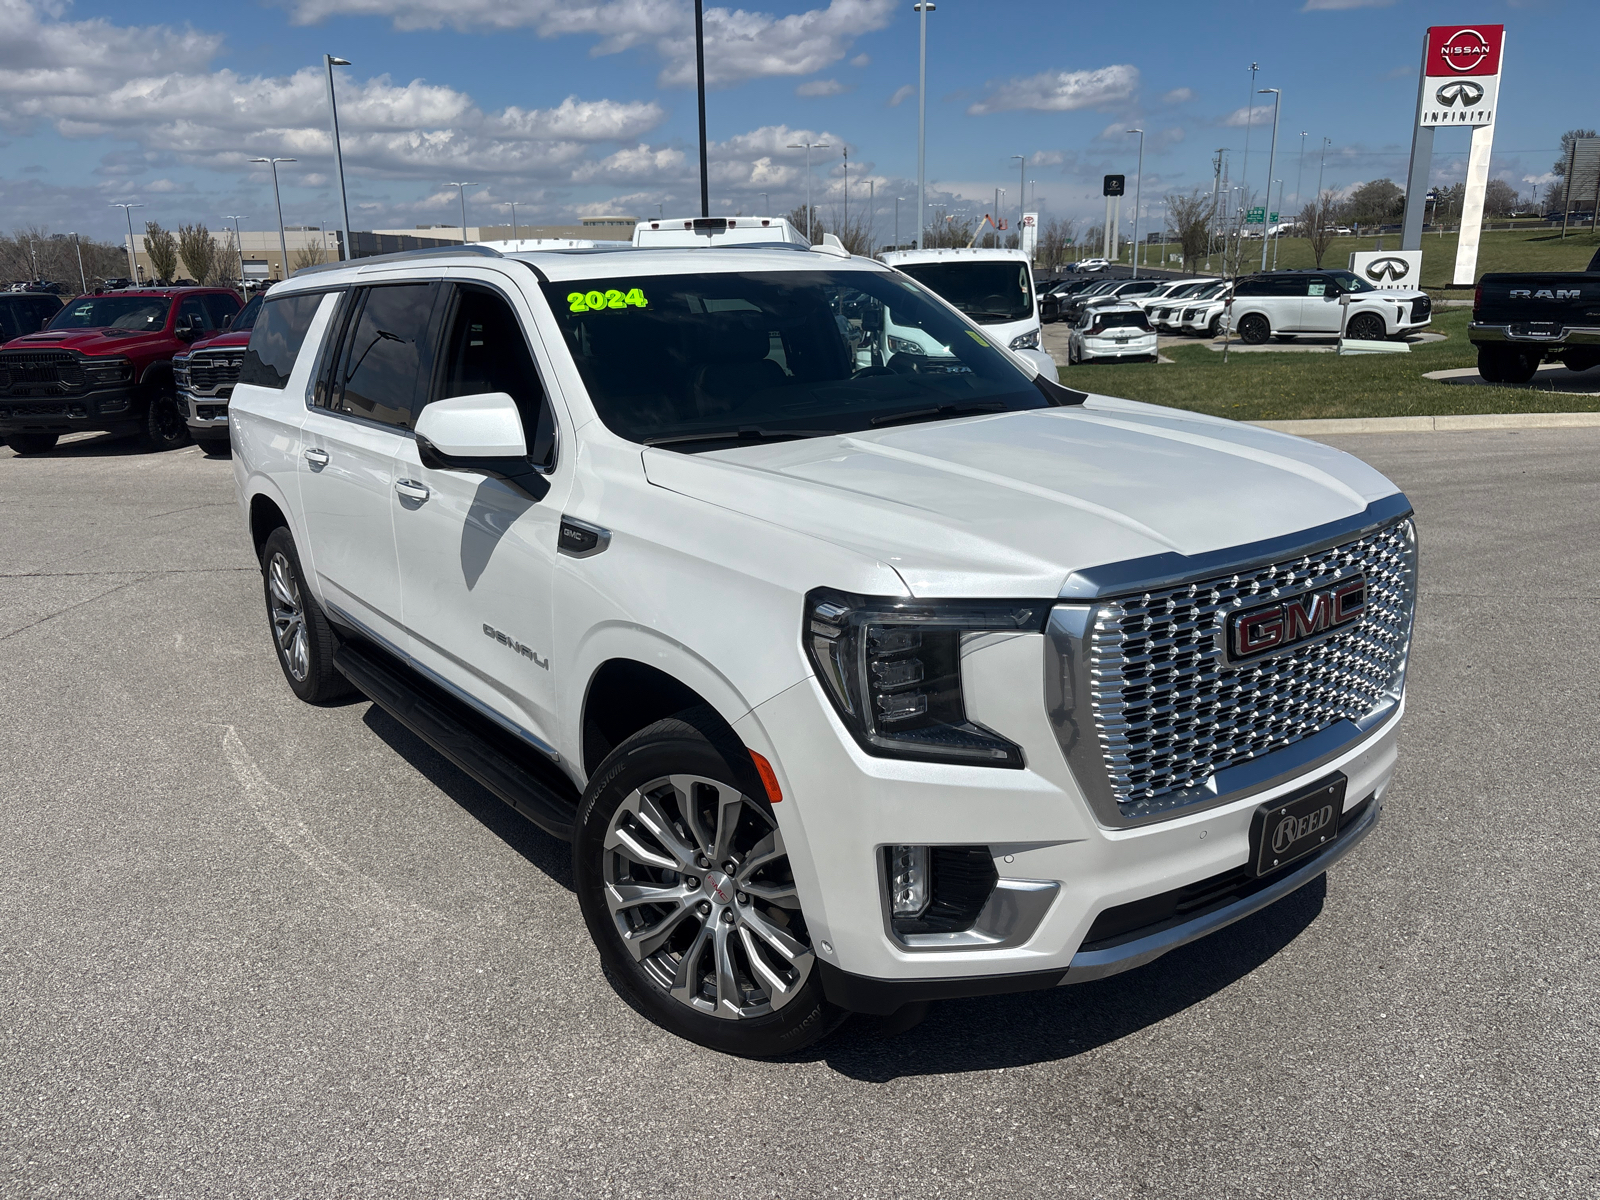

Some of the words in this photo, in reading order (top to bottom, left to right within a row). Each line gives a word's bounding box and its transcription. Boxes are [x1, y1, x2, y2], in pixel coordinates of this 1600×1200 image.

[1441, 45, 1490, 54] NISSAN
[1423, 110, 1491, 122] INFINITI
[567, 288, 648, 313] 2024
[1509, 289, 1581, 299] RAM
[563, 528, 582, 541] GMC
[1236, 580, 1365, 656] GMC
[482, 623, 549, 671] DENALI
[1273, 804, 1333, 849] REED
[707, 874, 729, 901] GMC
